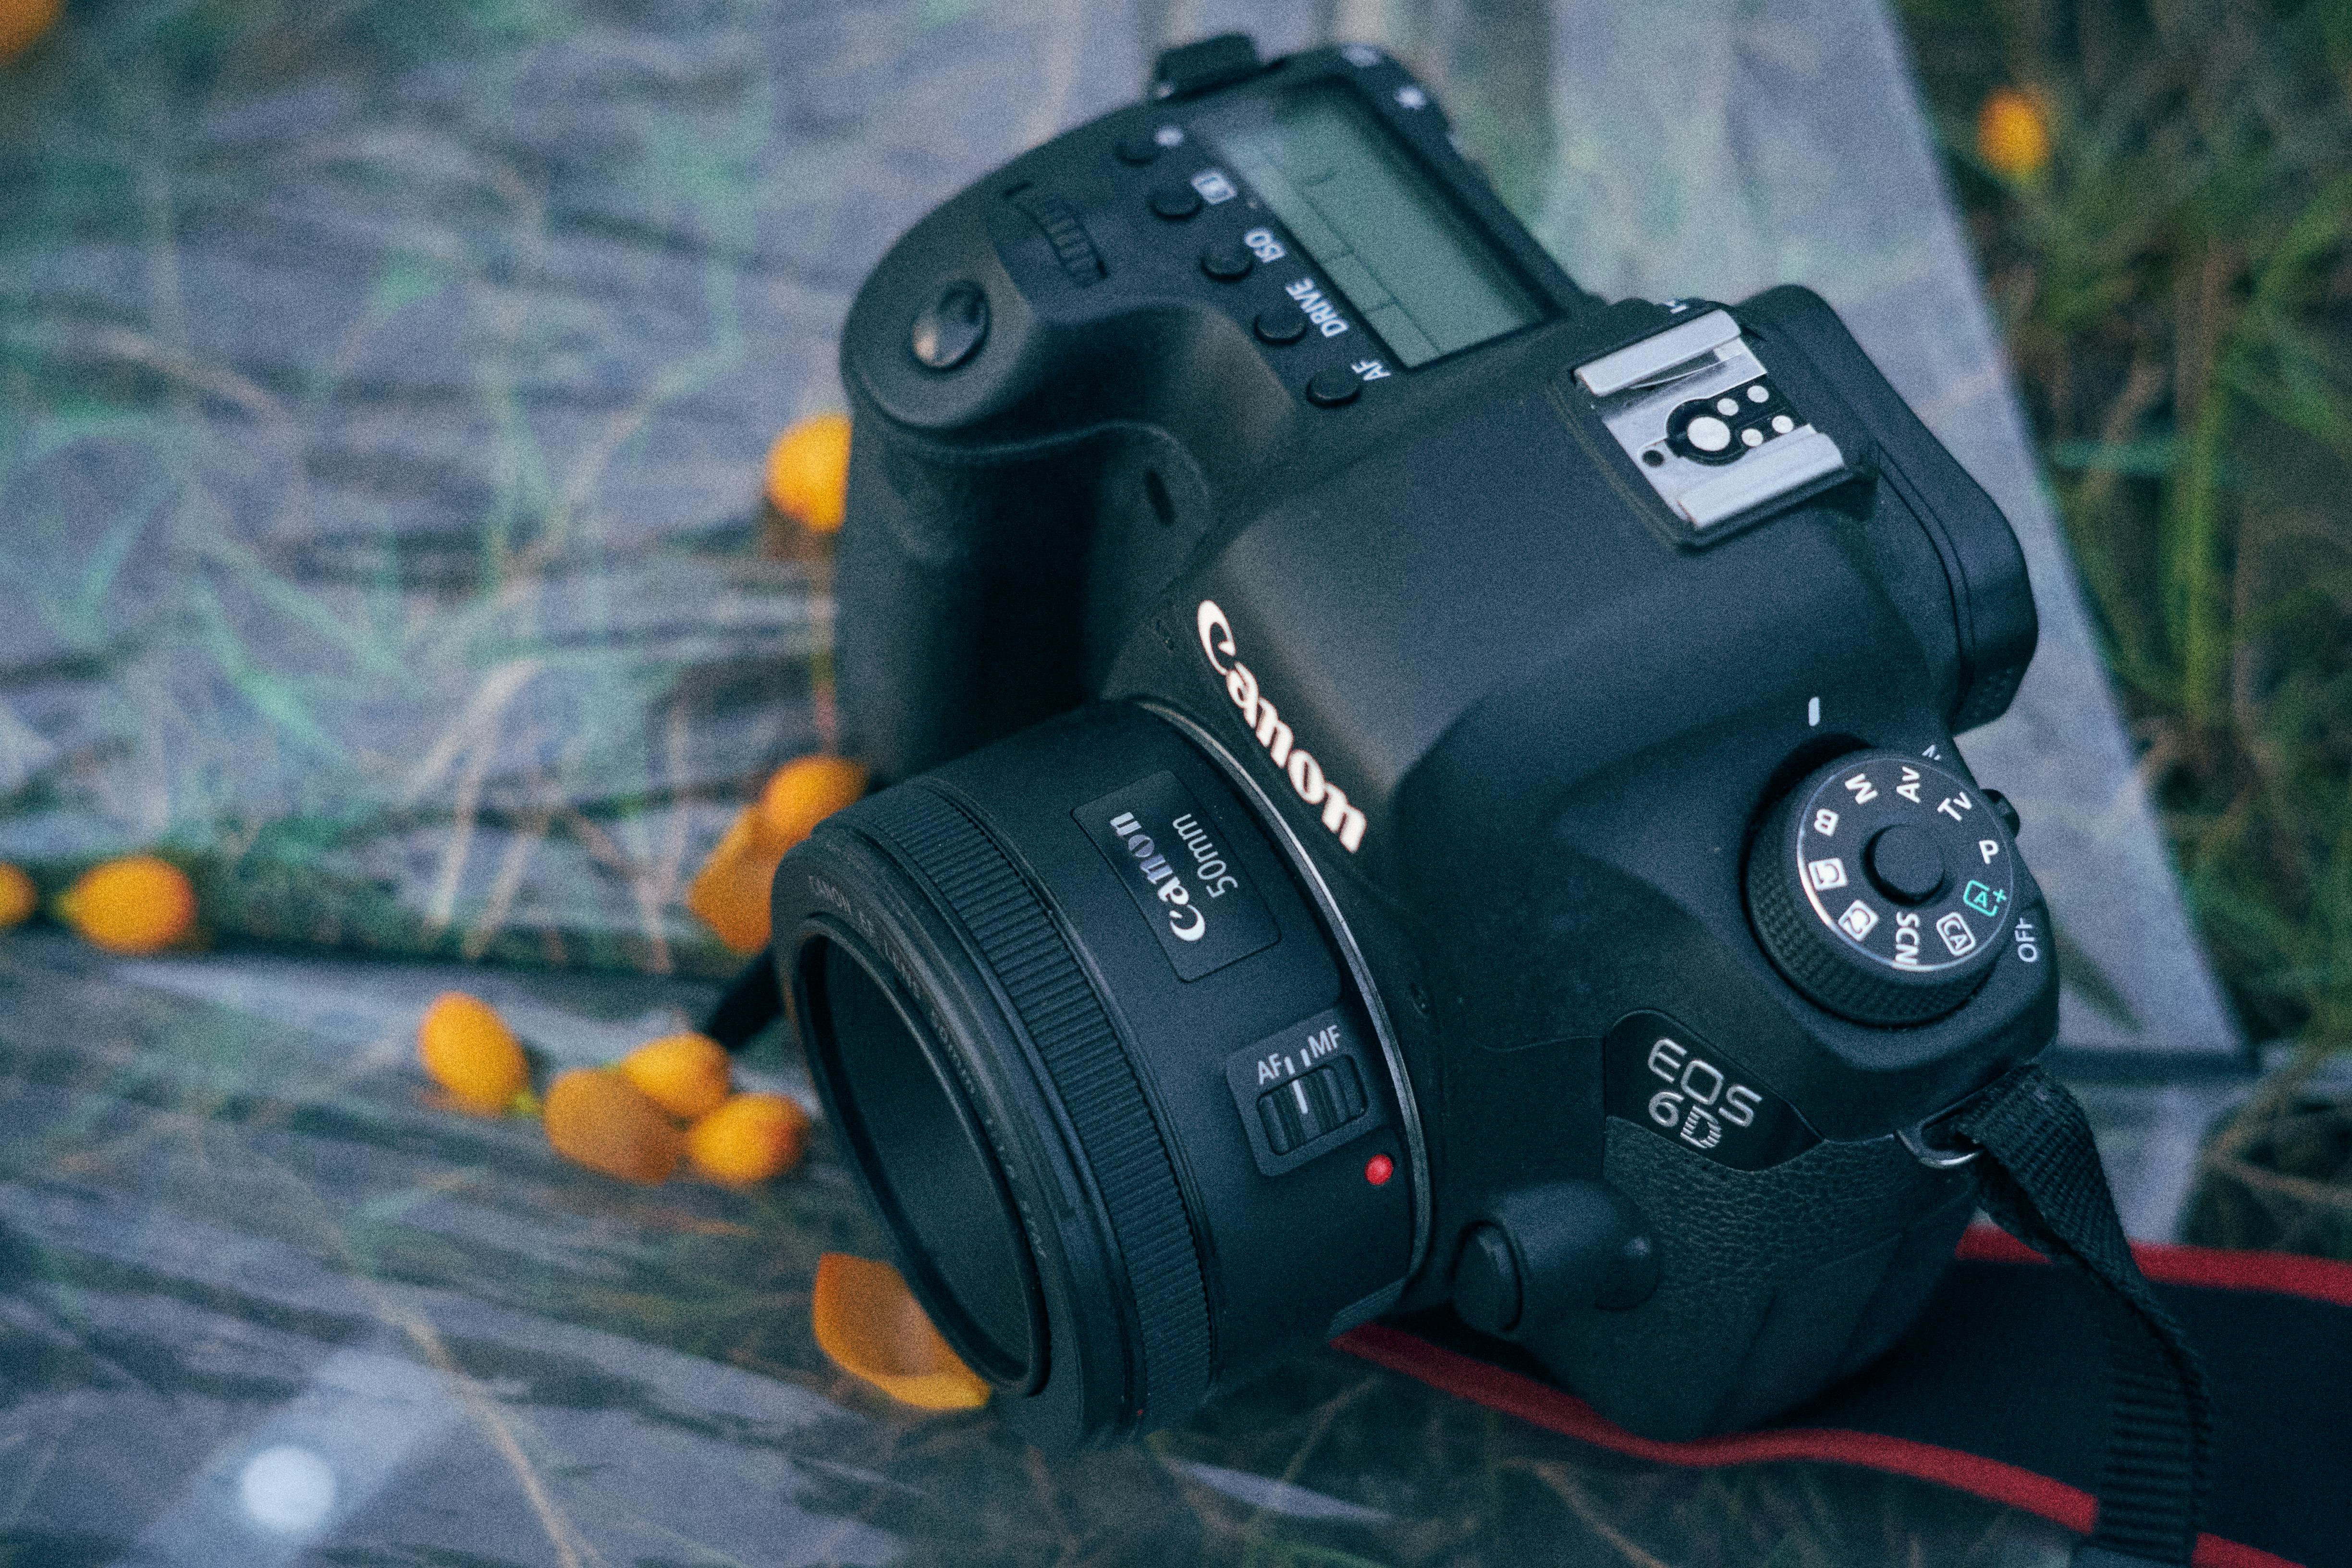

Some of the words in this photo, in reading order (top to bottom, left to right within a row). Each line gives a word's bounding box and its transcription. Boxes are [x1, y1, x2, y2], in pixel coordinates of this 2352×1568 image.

[1244, 228, 1286, 263] ISO
[1285, 278, 1348, 338] DRIVE
[1351, 360, 1391, 381] AF
[1197, 600, 1367, 854] Canon
[1896, 766, 1920, 803] Av
[1814, 808, 1839, 836] B
[1937, 792, 1972, 821] Tv
[1172, 813, 1238, 898] 50mm
[1979, 840, 1999, 865] P
[1110, 812, 1206, 942] Canon
[1895, 911, 1920, 964] SCN
[1308, 1024, 1340, 1058] MF
[1257, 1053, 1281, 1085] AF
[1647, 1037, 1763, 1127] EOS
[1648, 1091, 1722, 1149] 6D
